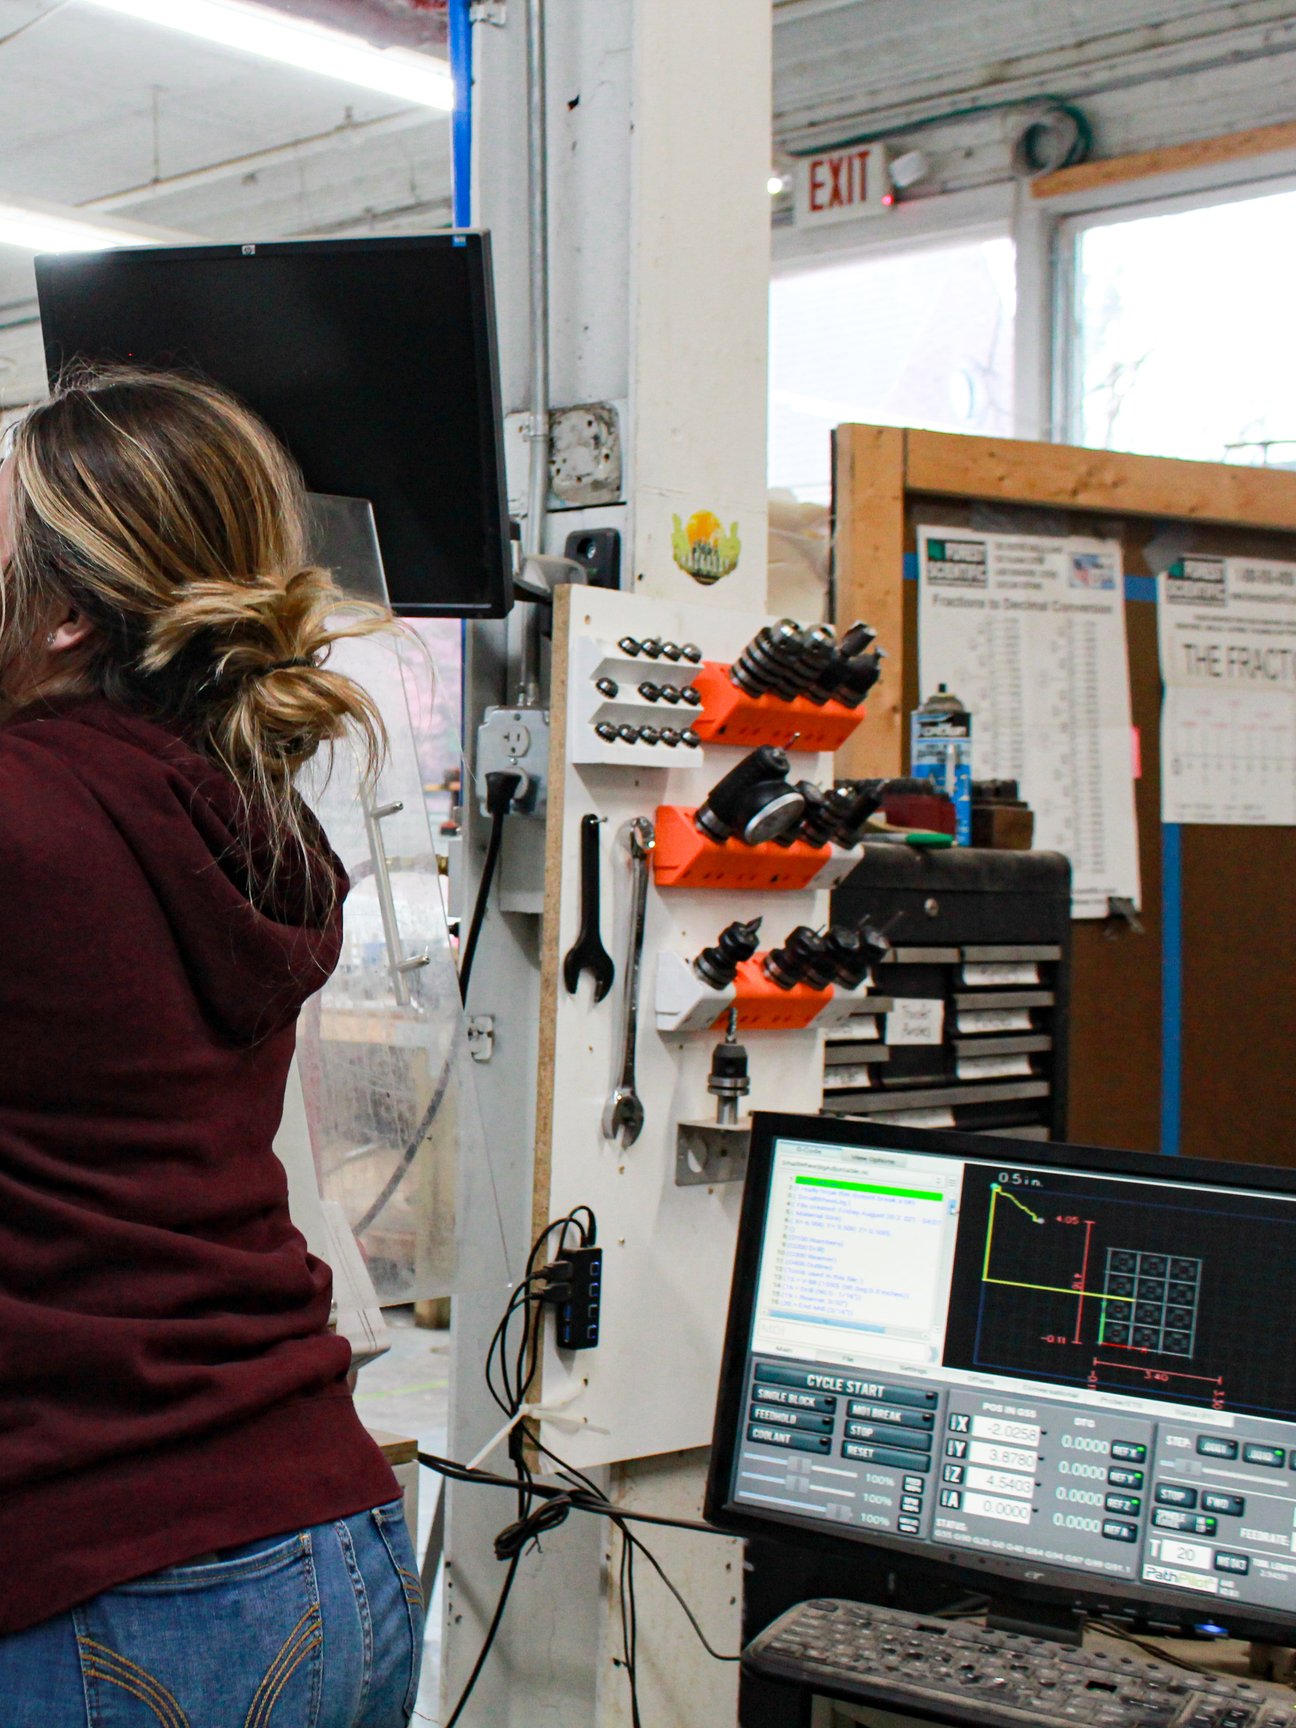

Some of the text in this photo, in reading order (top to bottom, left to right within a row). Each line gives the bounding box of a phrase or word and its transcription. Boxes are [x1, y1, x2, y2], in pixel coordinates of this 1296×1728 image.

[809, 150, 870, 212] EXIT
[1183, 643, 1222, 678] THE
[806, 1374, 886, 1399] CYCLE START
[757, 1388, 816, 1408] SINGLE BLOCK
[872, 1408, 902, 1423] BREAK
[752, 1428, 792, 1444] COOLANT
[850, 1425, 874, 1438] STOP
[846, 1444, 874, 1458] RESET
[1061, 1434, 1110, 1455] 0.0000
[865, 1473, 895, 1487] 100%
[1058, 1460, 1107, 1481] 0.0000
[863, 1492, 893, 1507] 100%
[1055, 1486, 1104, 1507] 0.0000
[983, 1500, 1028, 1519] 0.0000
[860, 1513, 891, 1527] 100%
[1053, 1512, 1102, 1533] 0.0000
[1149, 1539, 1161, 1558] T
[1177, 1546, 1196, 1562] 20
